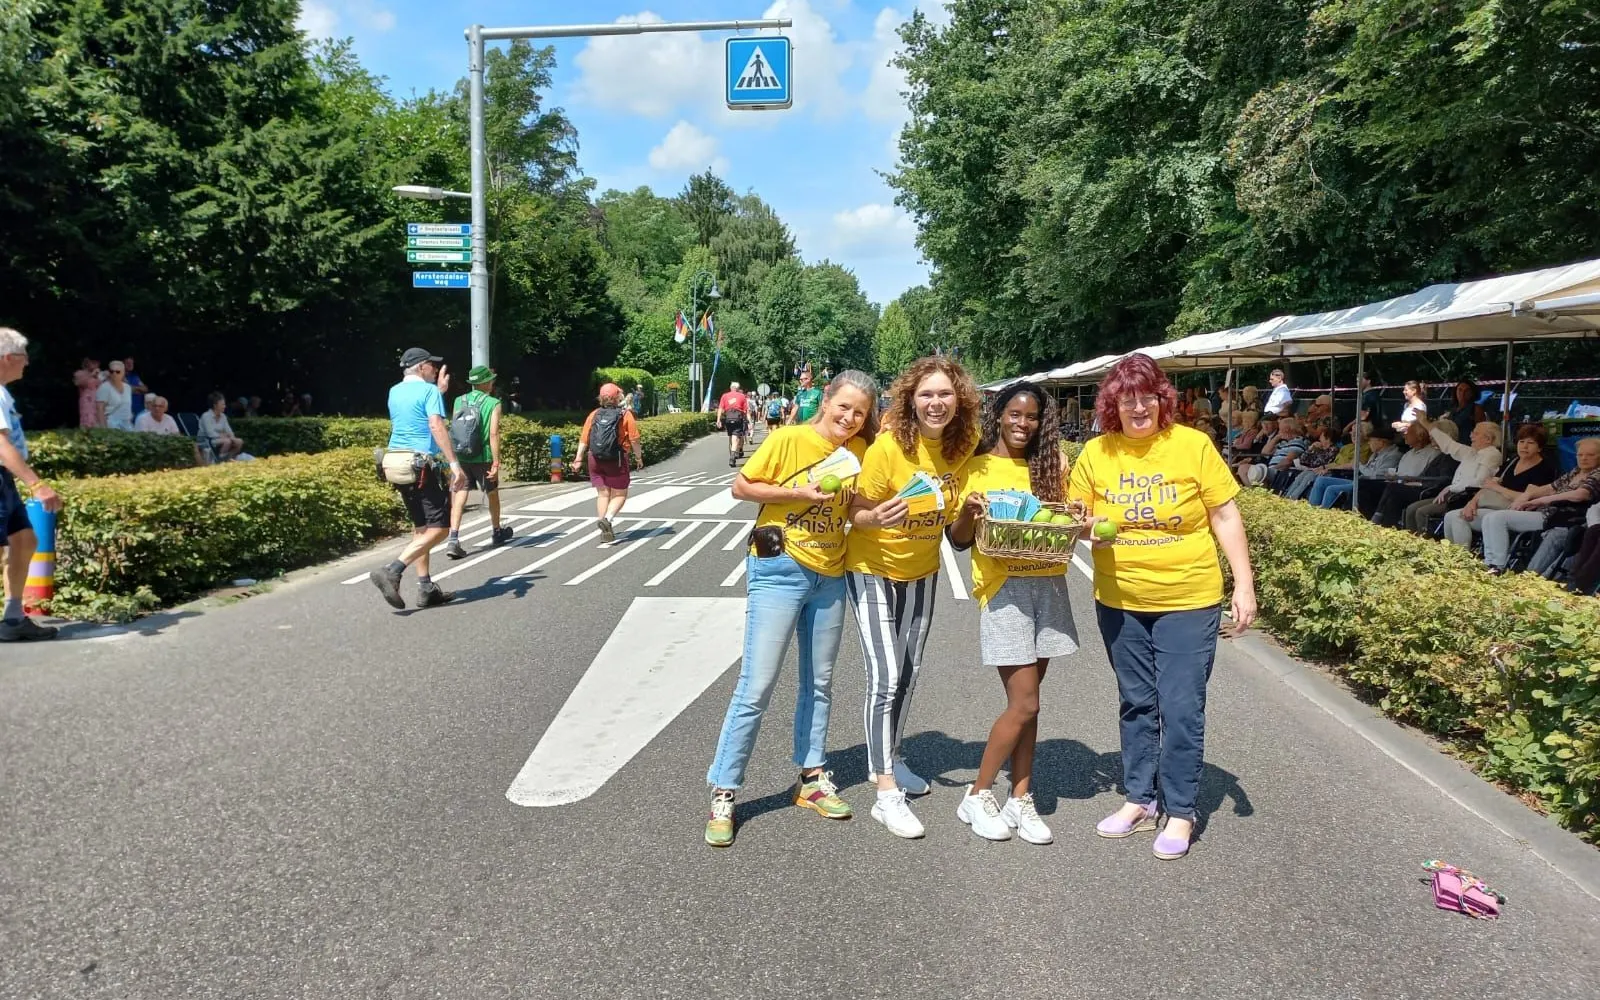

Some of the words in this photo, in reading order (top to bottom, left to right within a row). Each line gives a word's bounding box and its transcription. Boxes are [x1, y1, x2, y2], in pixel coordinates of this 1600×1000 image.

[1119, 472, 1163, 489] Hoe
[1104, 485, 1152, 504] haal
[1158, 481, 1177, 504] jij
[808, 501, 833, 516] de
[1124, 502, 1155, 521] de
